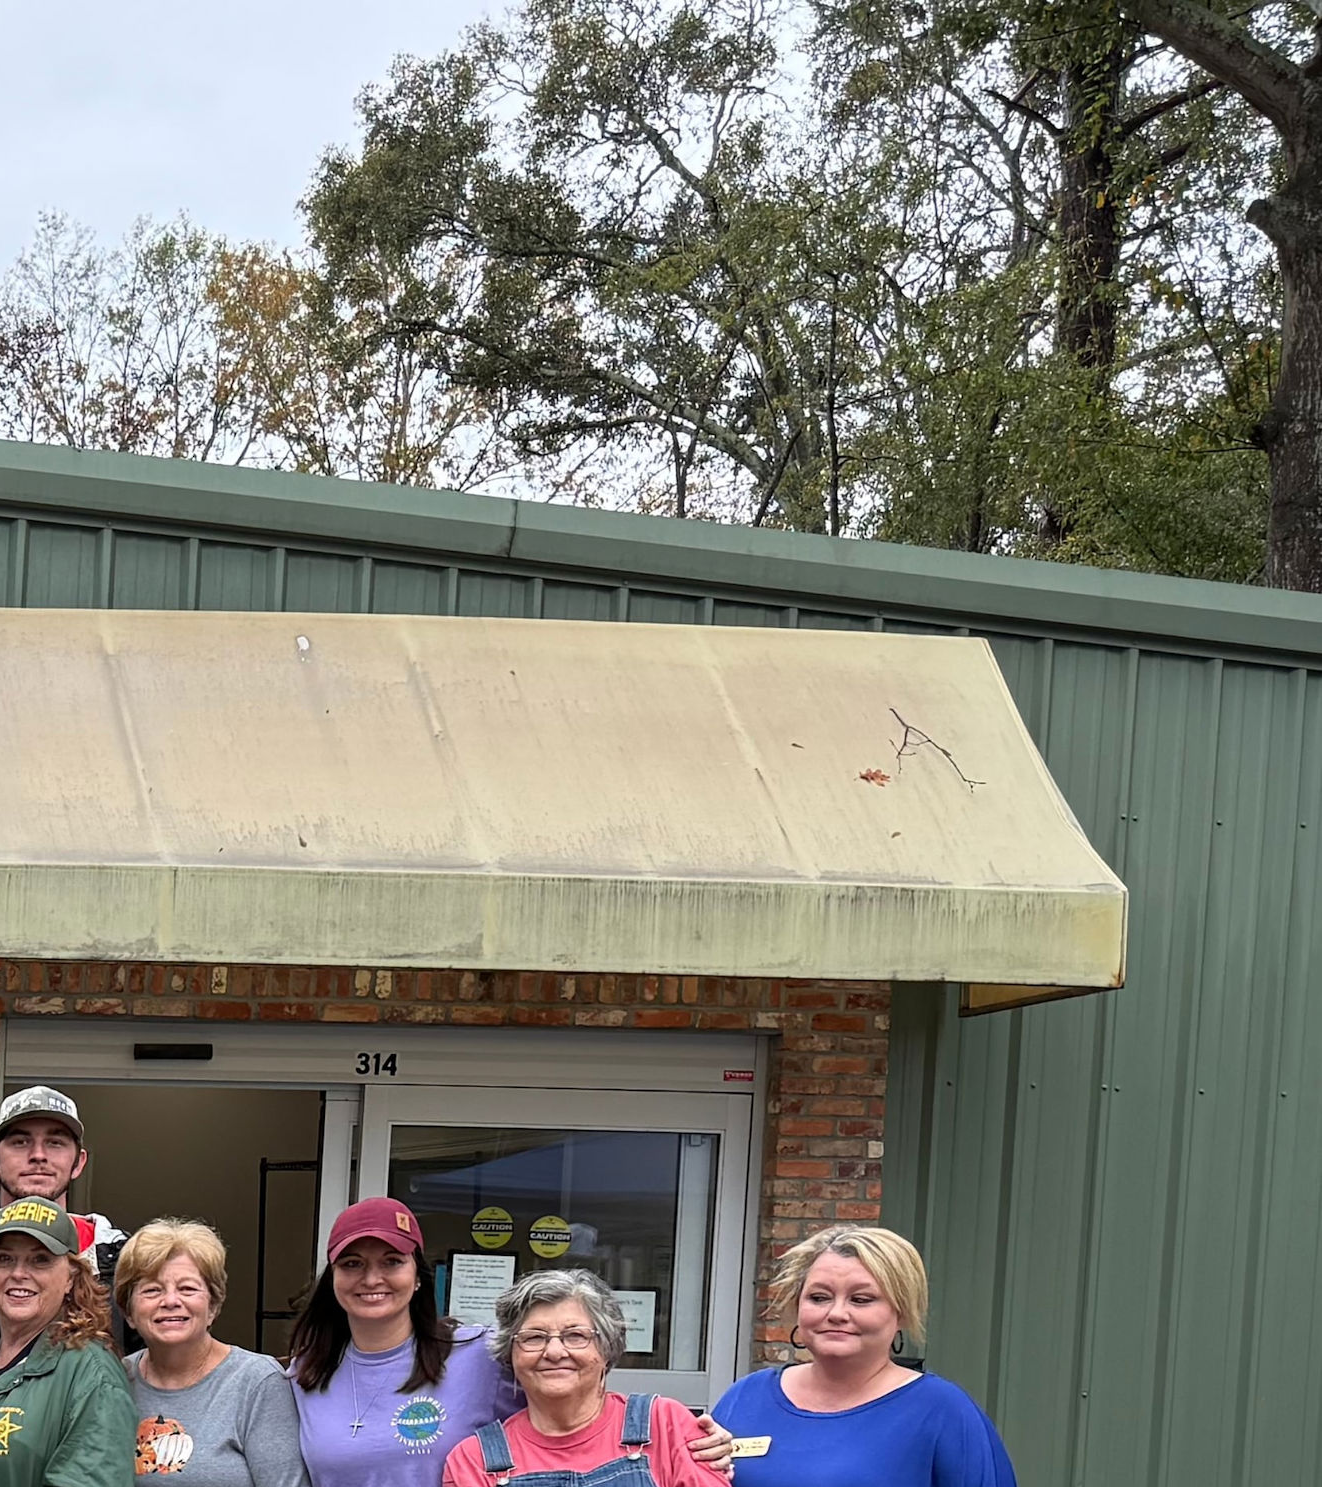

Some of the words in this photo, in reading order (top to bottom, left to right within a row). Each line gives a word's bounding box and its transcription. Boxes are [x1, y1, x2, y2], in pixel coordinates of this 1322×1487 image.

[355, 1052, 397, 1076] 314
[0, 1201, 57, 1226] SHERIFF
[472, 1223, 513, 1231] CAUTION
[530, 1232, 571, 1241] CAUTION
